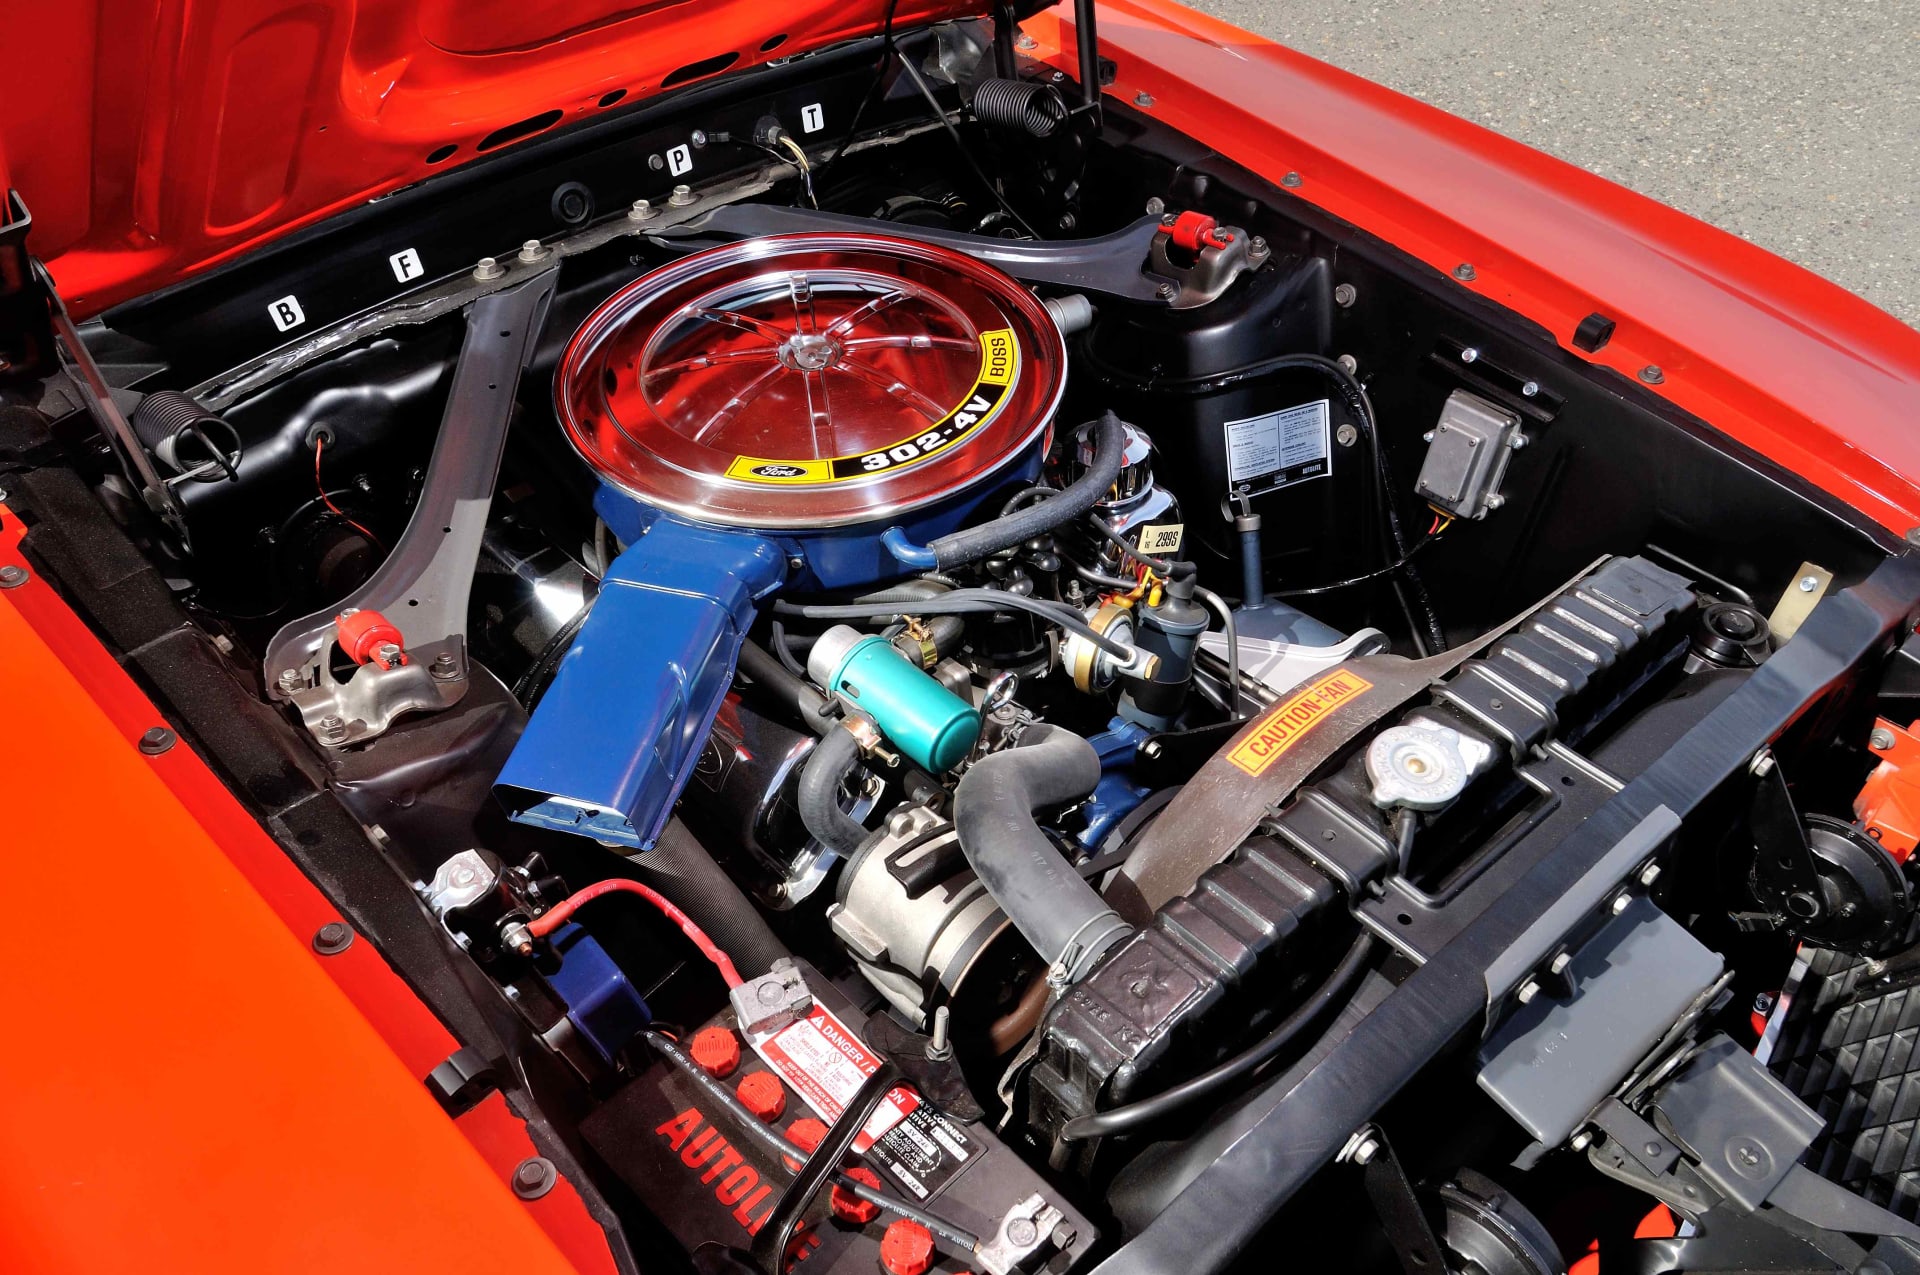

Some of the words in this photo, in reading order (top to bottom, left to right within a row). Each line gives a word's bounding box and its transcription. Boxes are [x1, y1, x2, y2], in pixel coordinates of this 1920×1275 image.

[807, 107, 817, 129] T
[673, 149, 684, 171] P
[397, 254, 411, 279] F
[275, 302, 297, 327] B
[990, 337, 1007, 377] BOSS
[861, 394, 992, 472] 302-4V
[1155, 530, 1179, 548] 299S
[821, 1023, 864, 1064] DANGER
[932, 1111, 967, 1145] CONNECT
[902, 1135, 934, 1166] ADJUSTMENT
[903, 1152, 920, 1168] CLAIM
[655, 1107, 822, 1274] AUTOLE
[951, 1235, 975, 1251] AUTOLI
